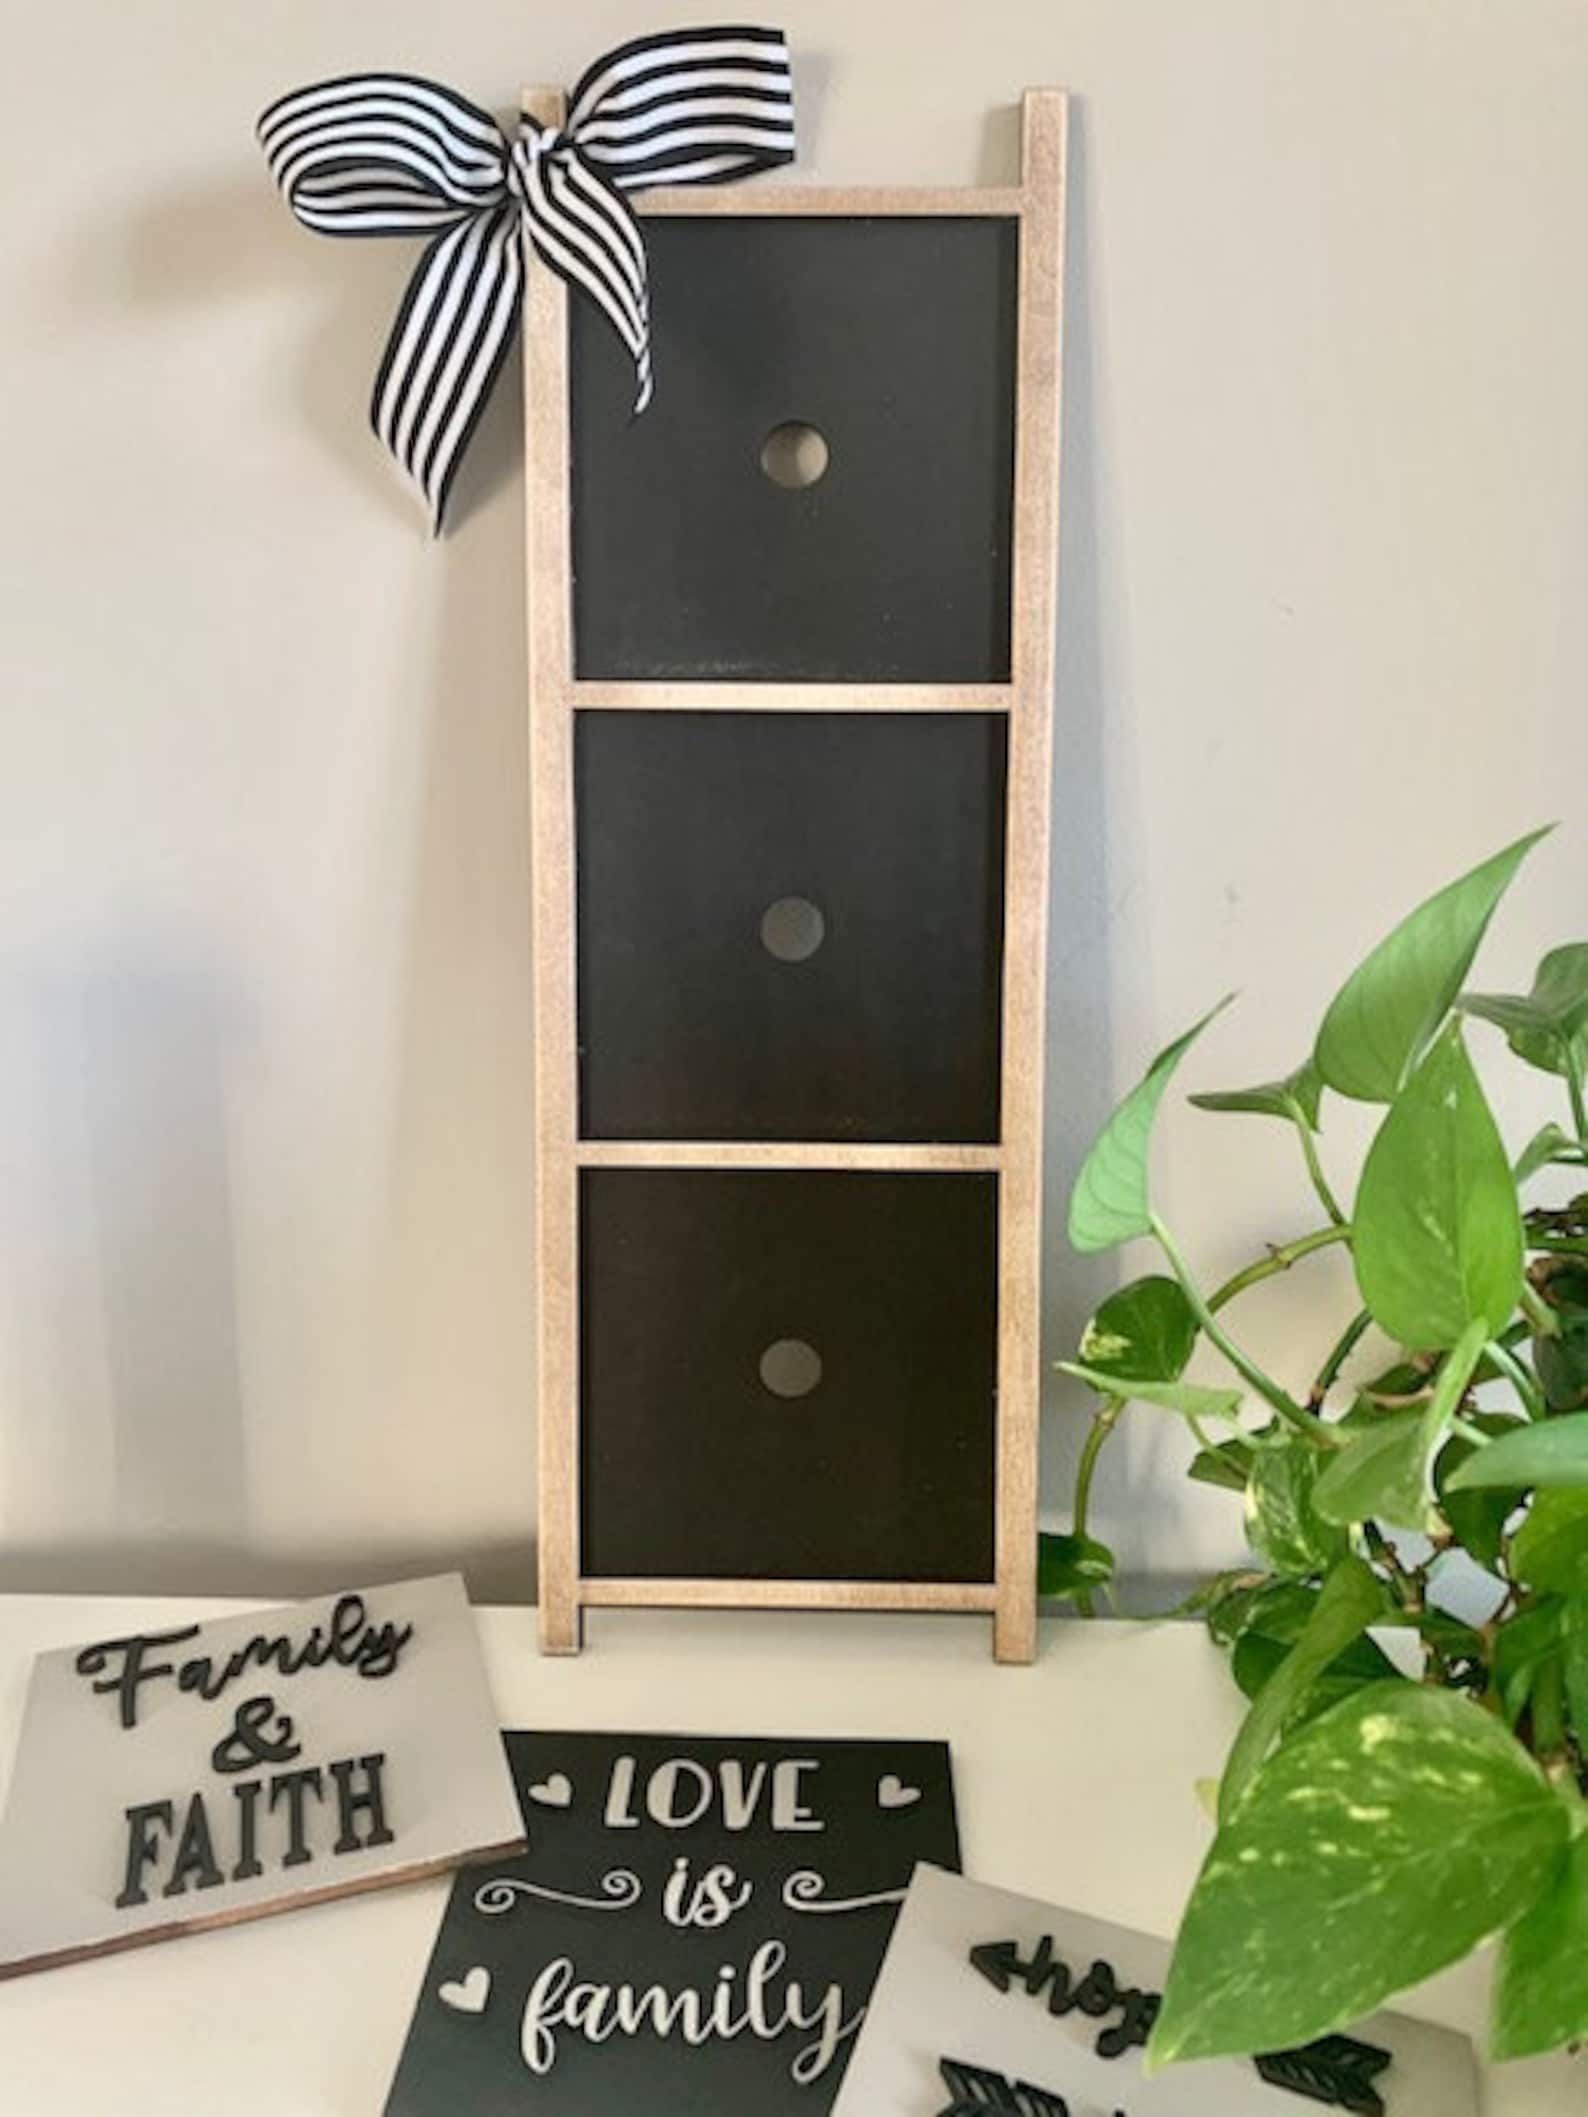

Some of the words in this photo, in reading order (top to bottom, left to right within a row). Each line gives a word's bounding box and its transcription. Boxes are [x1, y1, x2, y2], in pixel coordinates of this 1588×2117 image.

[76, 1593, 413, 1730] Family
[211, 1696, 302, 1773] &
[114, 1752, 396, 1908] FAITH
[604, 1755, 826, 1832] LOVE
[662, 1856, 752, 1927] is
[521, 1939, 866, 2083] family
